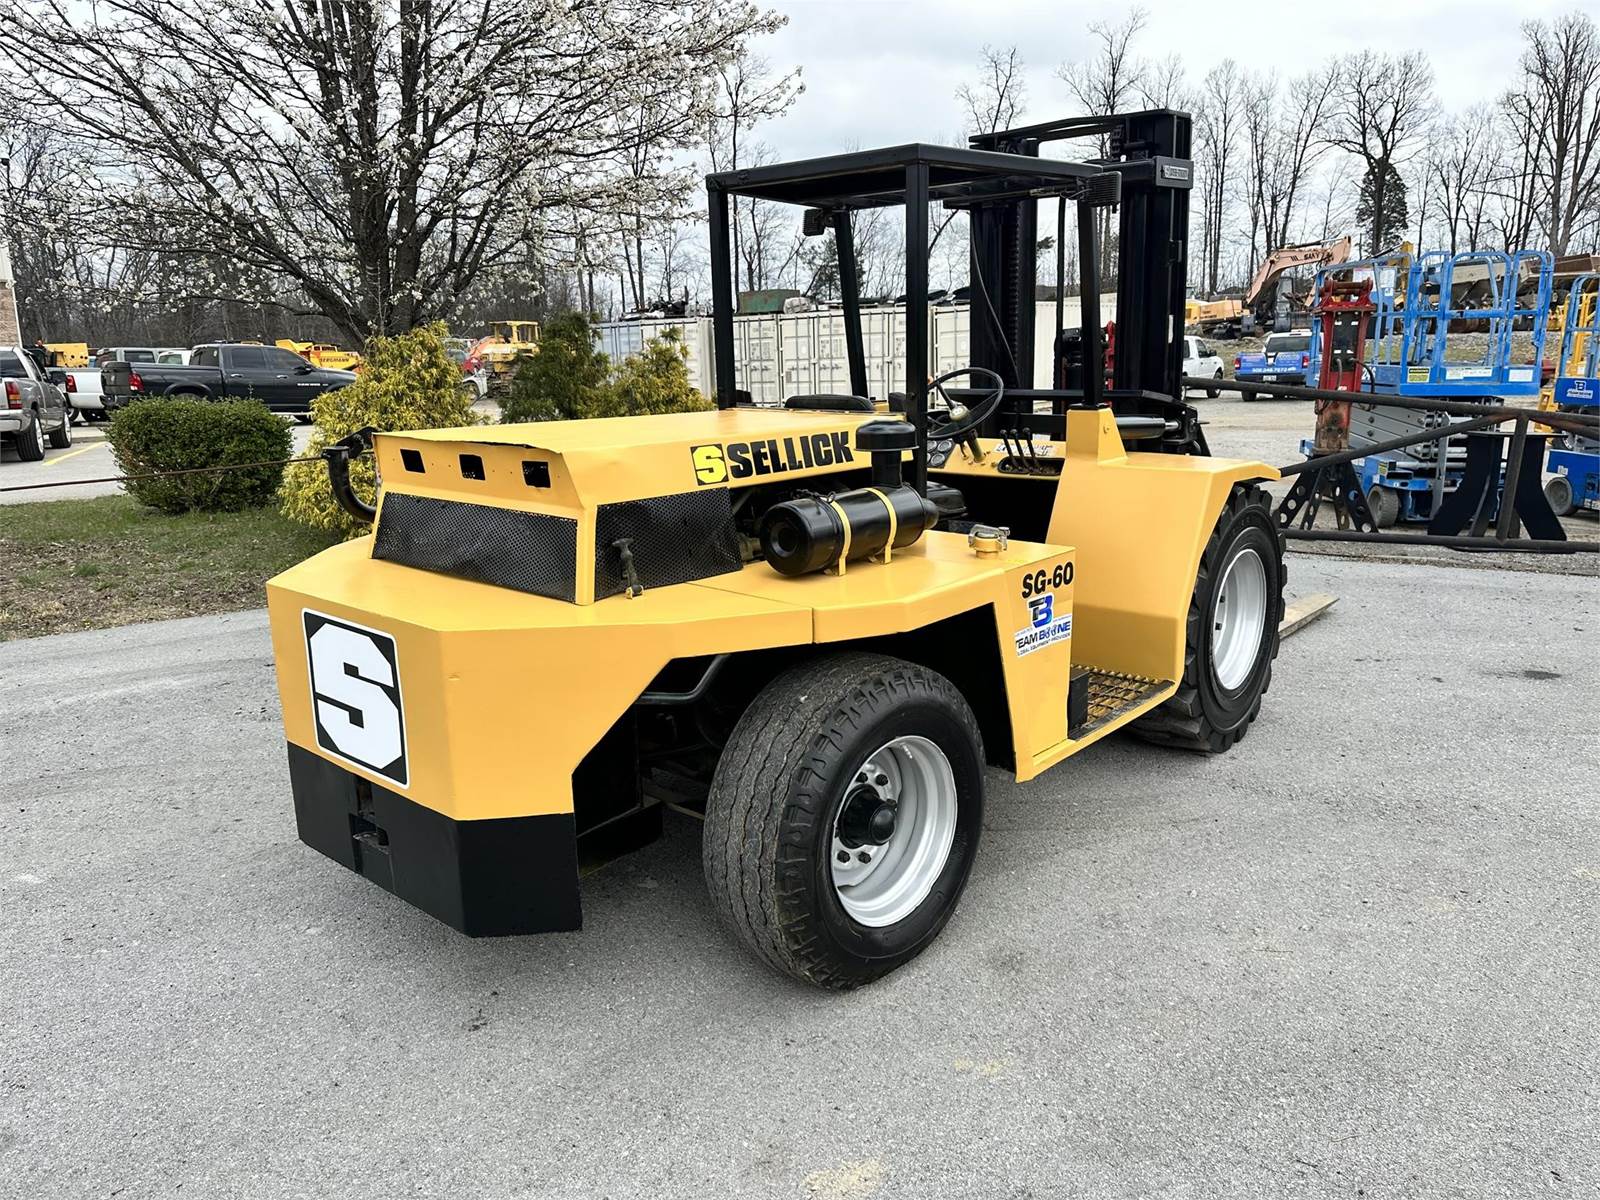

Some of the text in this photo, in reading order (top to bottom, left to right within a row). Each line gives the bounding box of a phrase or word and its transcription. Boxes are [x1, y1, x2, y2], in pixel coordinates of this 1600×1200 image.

[726, 431, 854, 479] SELLICK
[1022, 562, 1074, 599] SG-60
[309, 622, 403, 770] S
